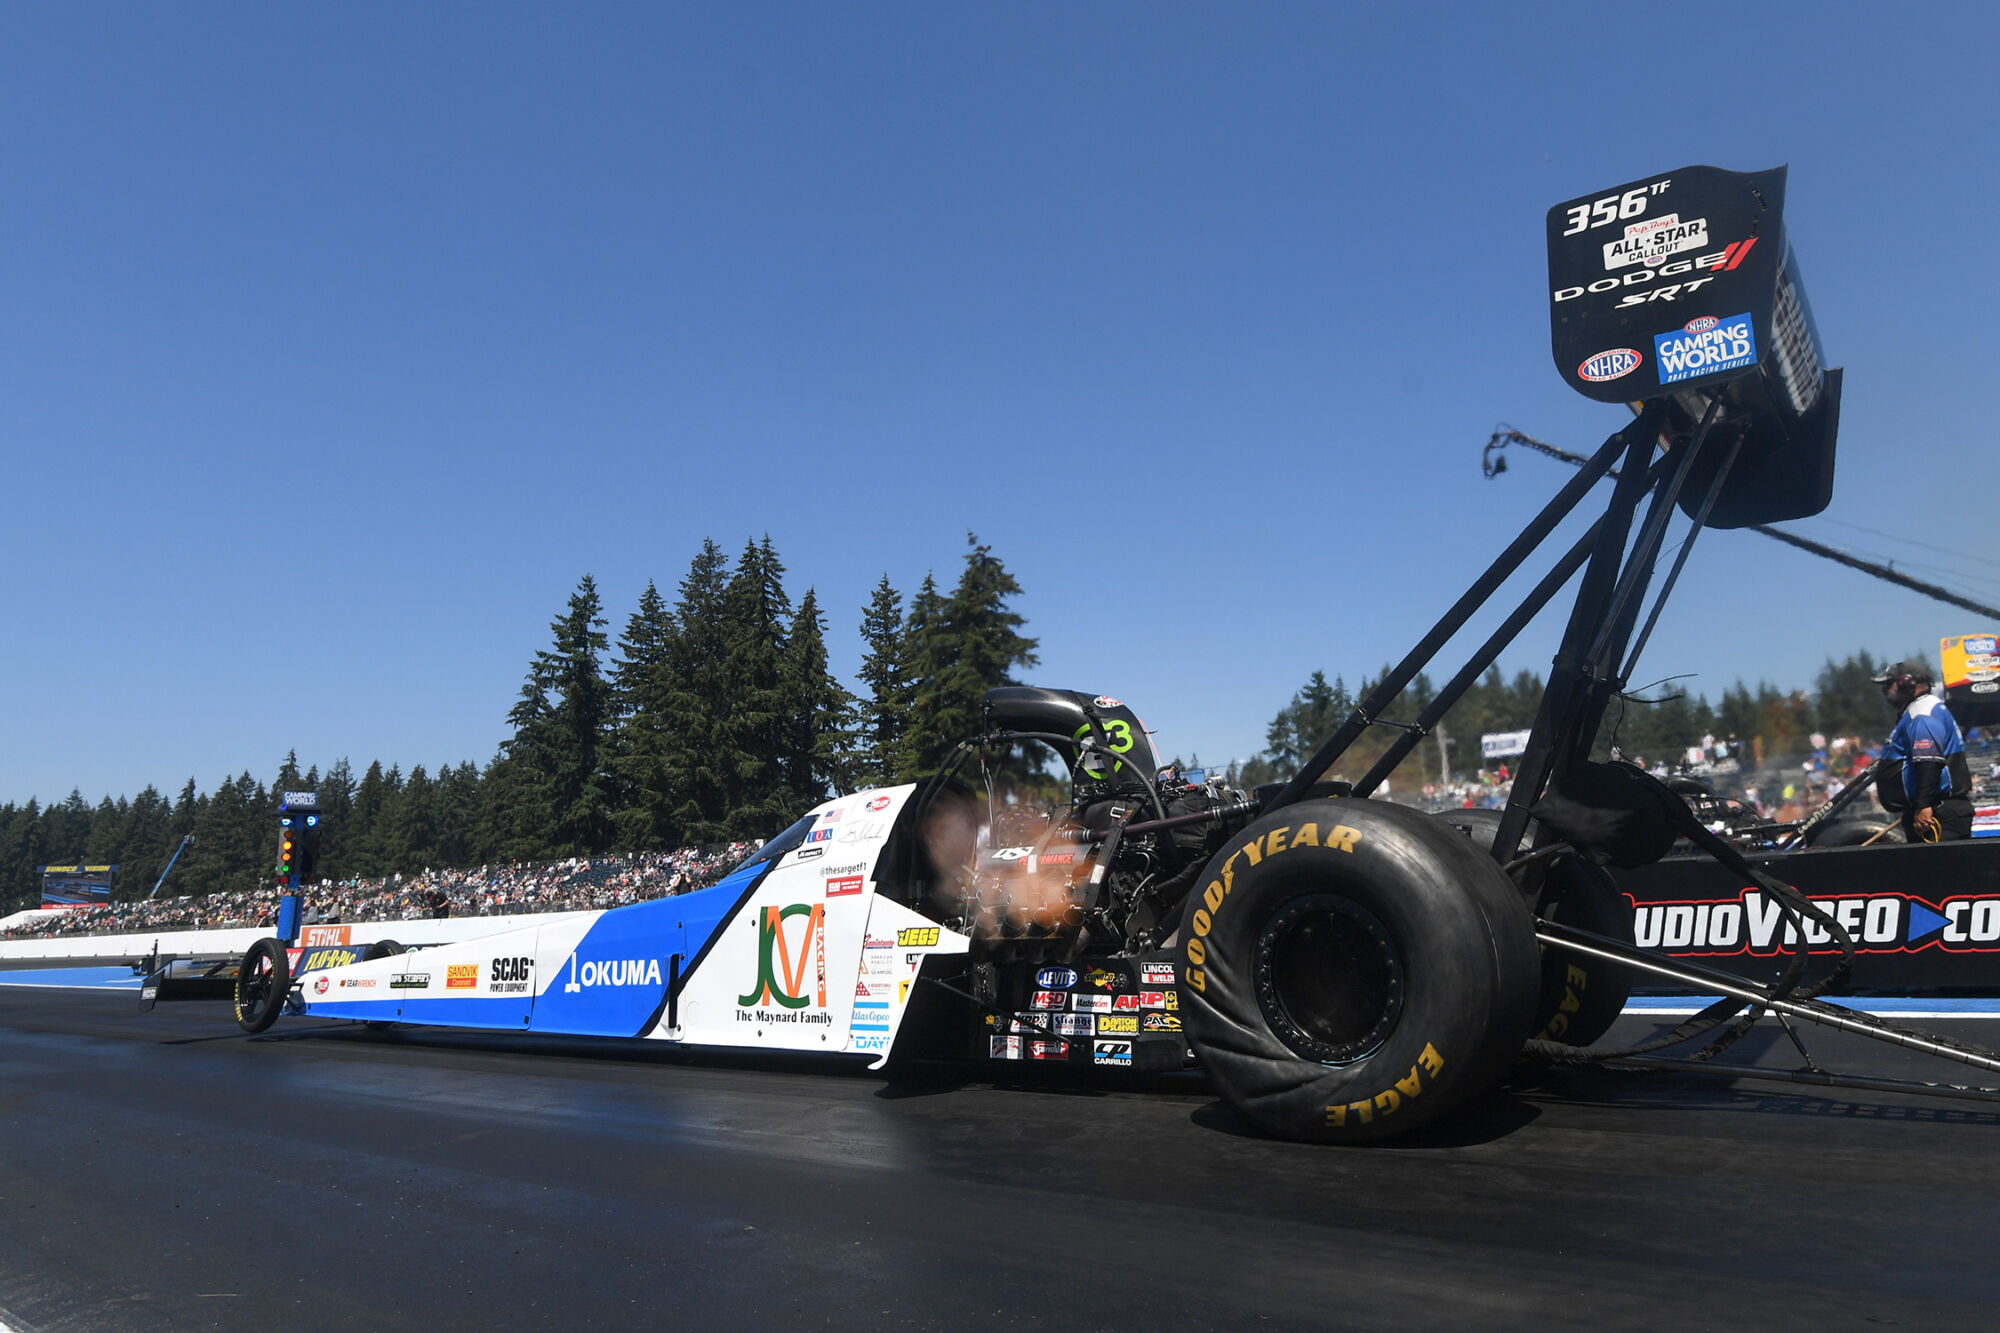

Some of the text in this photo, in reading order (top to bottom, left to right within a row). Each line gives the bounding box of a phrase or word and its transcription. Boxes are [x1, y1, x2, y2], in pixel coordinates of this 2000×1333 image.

[1563, 180, 1671, 237] 356 TF
[1628, 217, 1675, 235] Pep Boys
[1611, 222, 1700, 257] ALL STAR
[1628, 242, 1680, 261] CALLOUT
[1554, 250, 1728, 302] DODGE
[1615, 276, 1714, 309] SRT
[1689, 319, 1715, 332] NHRA
[1659, 323, 1749, 357] CAMPING
[1588, 354, 1633, 376] NHRA
[1661, 339, 1751, 373] WORLD
[1668, 357, 1750, 382] DRAG RACING SERIES
[285, 797, 316, 805] WORLD
[808, 829, 832, 842] IOA
[821, 862, 867, 877] @thesargetf1
[1186, 822, 1363, 993] GOODYEAR
[898, 927, 940, 947] JEGS
[491, 957, 529, 981] SCAG
[817, 927, 825, 993] RACING
[448, 966, 478, 977] SANDVIK
[580, 959, 663, 986] OKUMA
[1037, 969, 1077, 985] CLEVITE
[346, 979, 377, 988] GEARWRENCH
[490, 983, 528, 992] POWER EQUIPMENT
[1033, 992, 1065, 1004] MSD
[736, 1010, 833, 1027] The Maynard Family
[870, 1010, 889, 1023] Copco
[1094, 1058, 1132, 1066] CARRILLO
[1325, 1041, 1445, 1127] EAGLE
